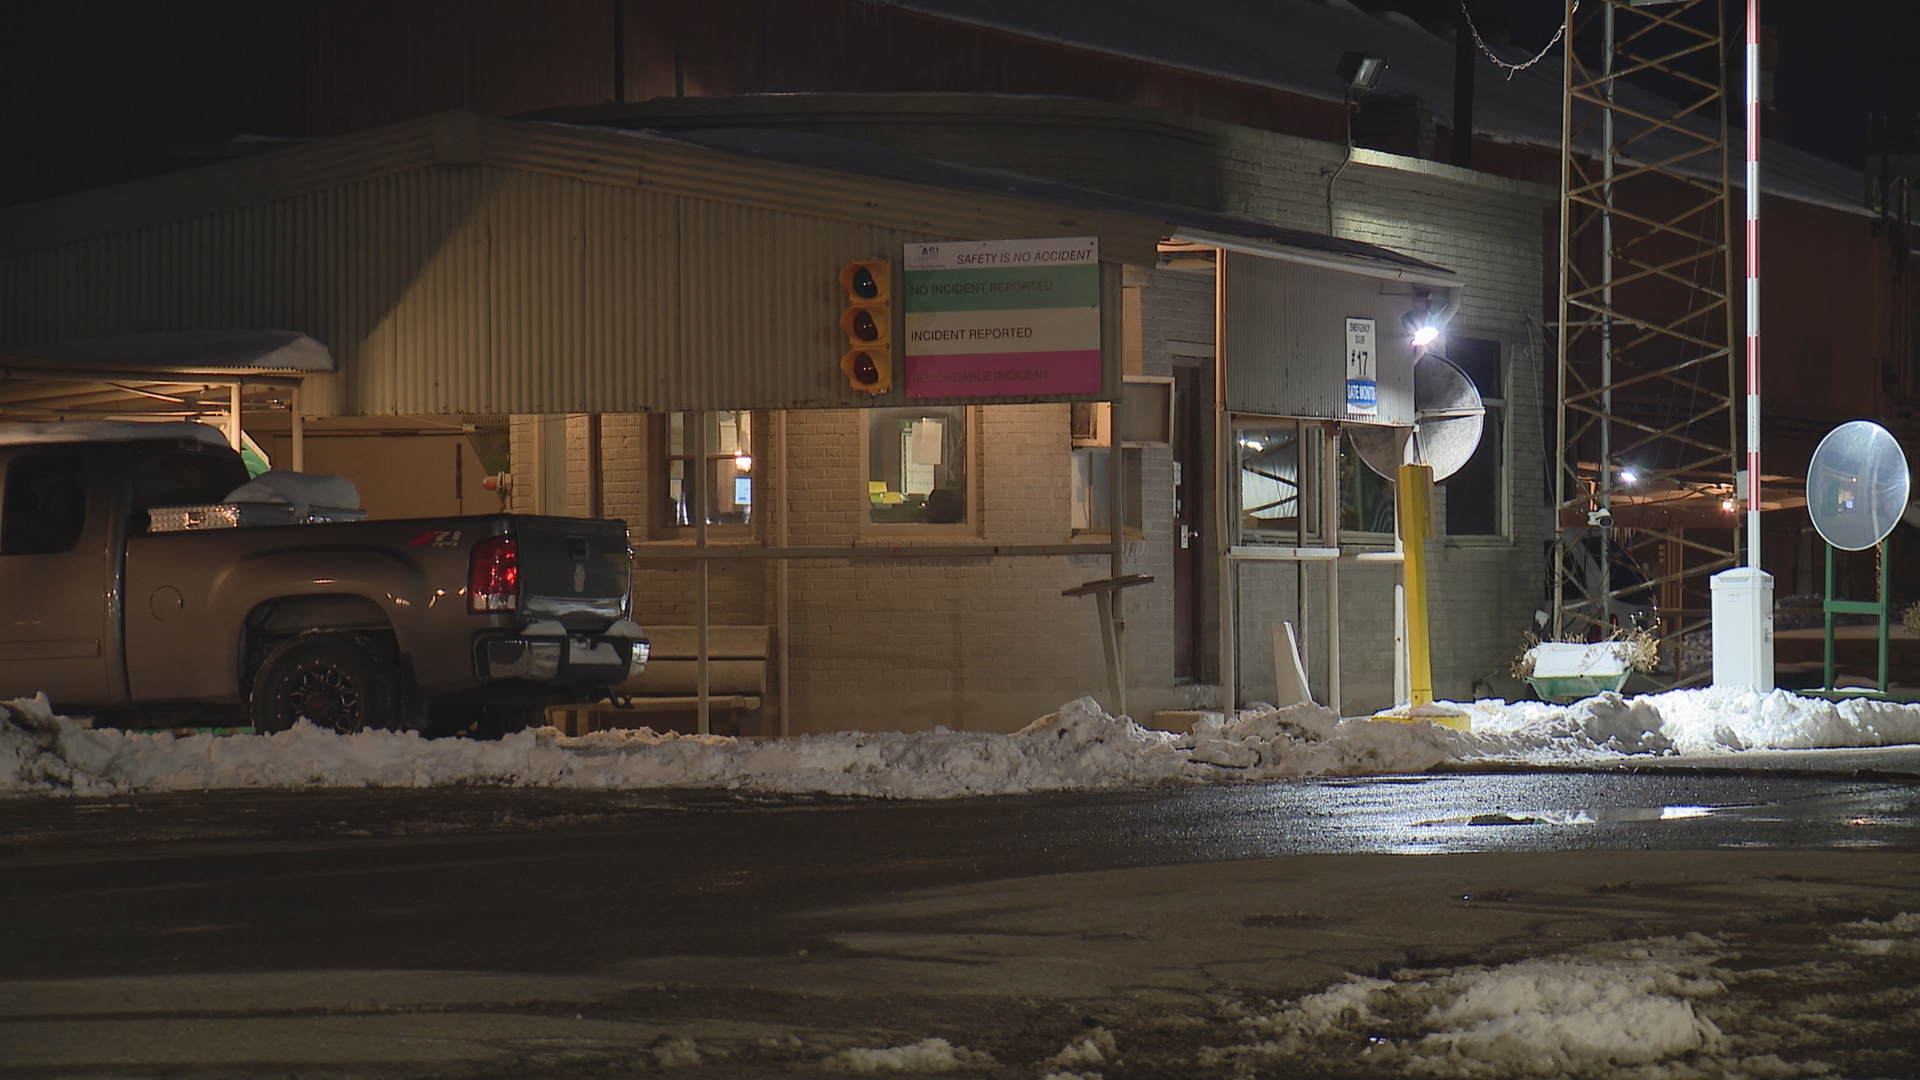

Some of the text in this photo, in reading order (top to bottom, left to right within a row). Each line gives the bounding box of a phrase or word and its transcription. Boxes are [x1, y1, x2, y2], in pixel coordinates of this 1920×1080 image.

[922, 247, 939, 257] ASI
[956, 249, 1092, 265] SAFETY IS NO ACCIDENT
[910, 280, 1053, 296] NO INCIDENT REPORTED
[911, 327, 1033, 342] INCIDENT REPORTED
[994, 369, 1049, 382] INCIDENT
